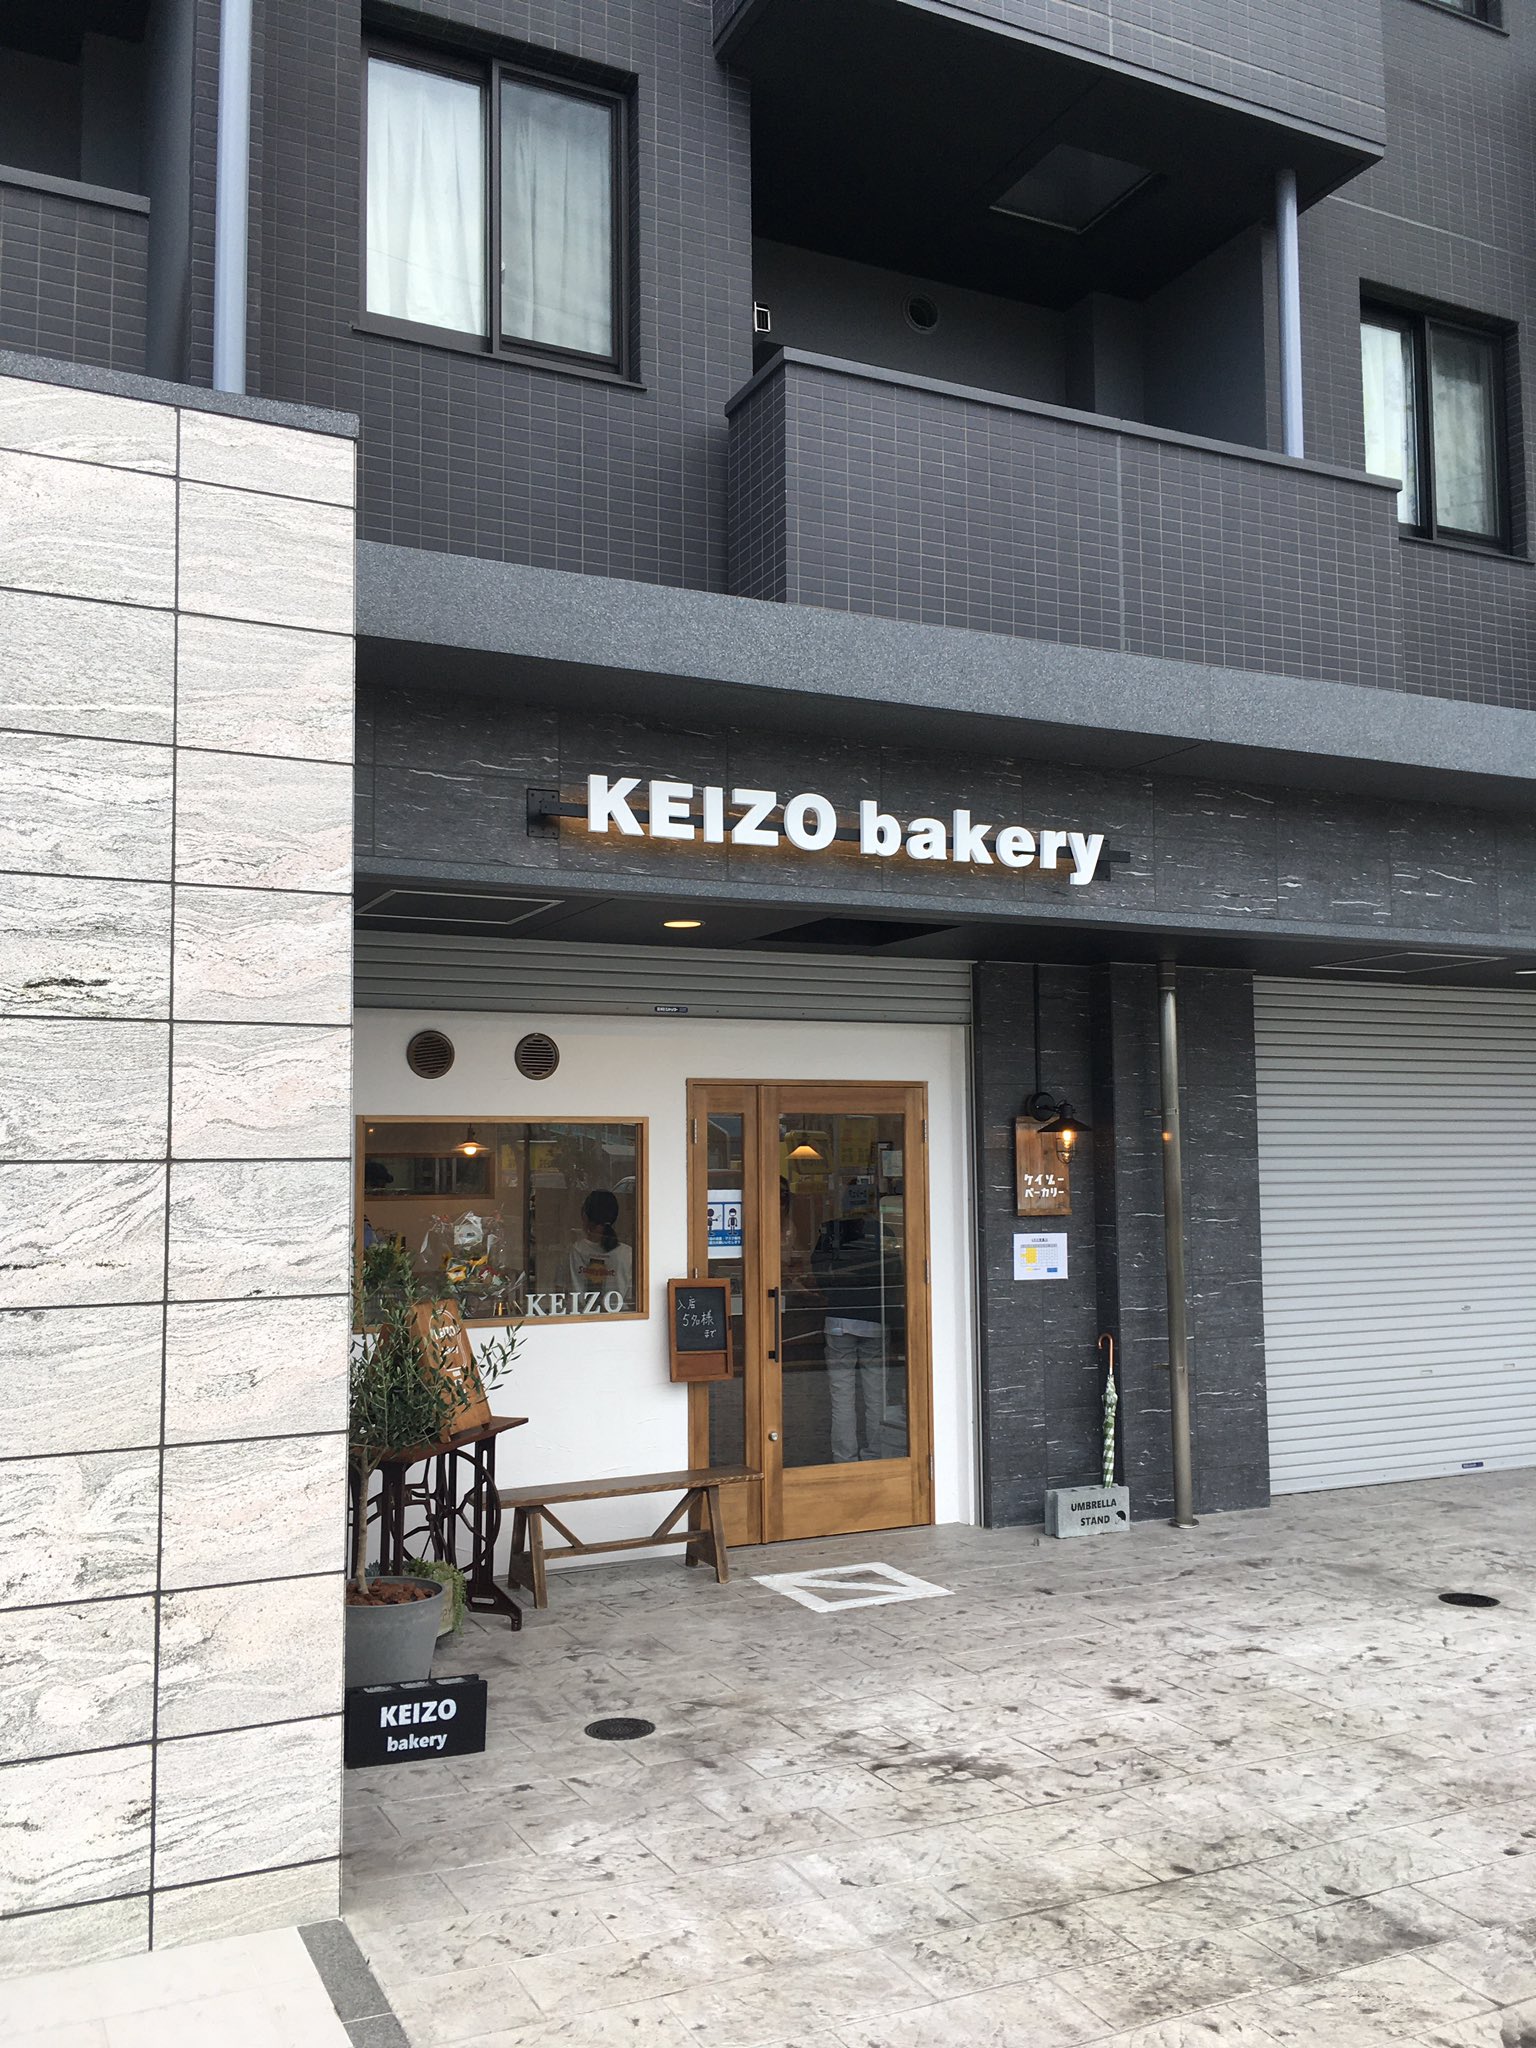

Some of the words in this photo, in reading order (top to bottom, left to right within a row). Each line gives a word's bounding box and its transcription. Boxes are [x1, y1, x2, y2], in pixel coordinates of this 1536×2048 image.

[587, 774, 838, 851] KEIZO
[859, 799, 1105, 885] bakery
[525, 1291, 624, 1317] KEIZO
[677, 1296, 696, 1310] 入店
[1070, 1498, 1117, 1512] UMBRELLA
[1080, 1515, 1110, 1527] STAND
[380, 1698, 457, 1728] KEIZO
[386, 1733, 448, 1752] bakery
